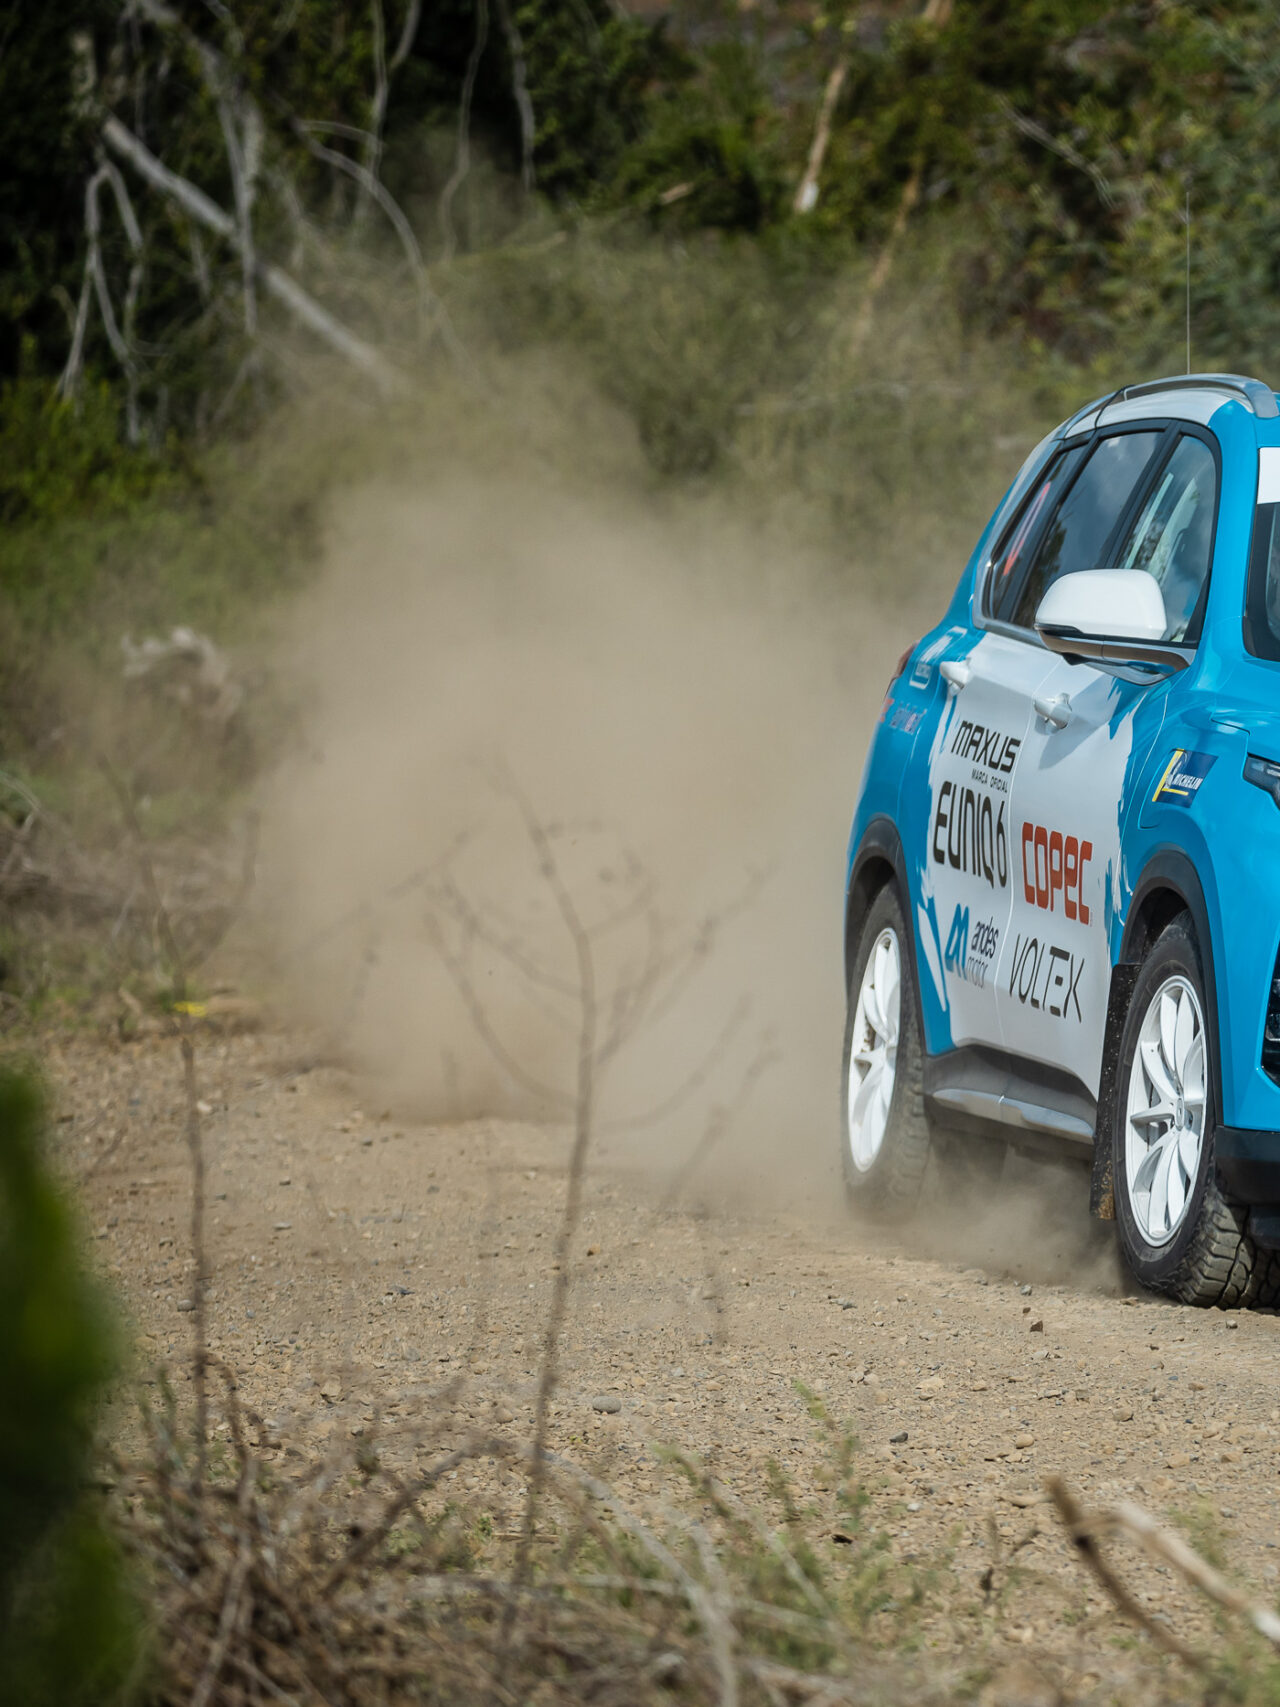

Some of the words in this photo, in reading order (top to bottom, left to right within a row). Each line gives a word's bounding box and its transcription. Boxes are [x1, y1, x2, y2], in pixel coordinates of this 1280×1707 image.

[952, 719, 1021, 773] MAXUS
[971, 769, 988, 784] MARCA
[1172, 773, 1204, 790] MICHELIN
[933, 780, 995, 889] EUNIQ
[996, 800, 1008, 888] 6
[1022, 821, 1093, 925] COPEC
[971, 916, 999, 959] andes
[1009, 933, 1086, 1024] VOLTEX
